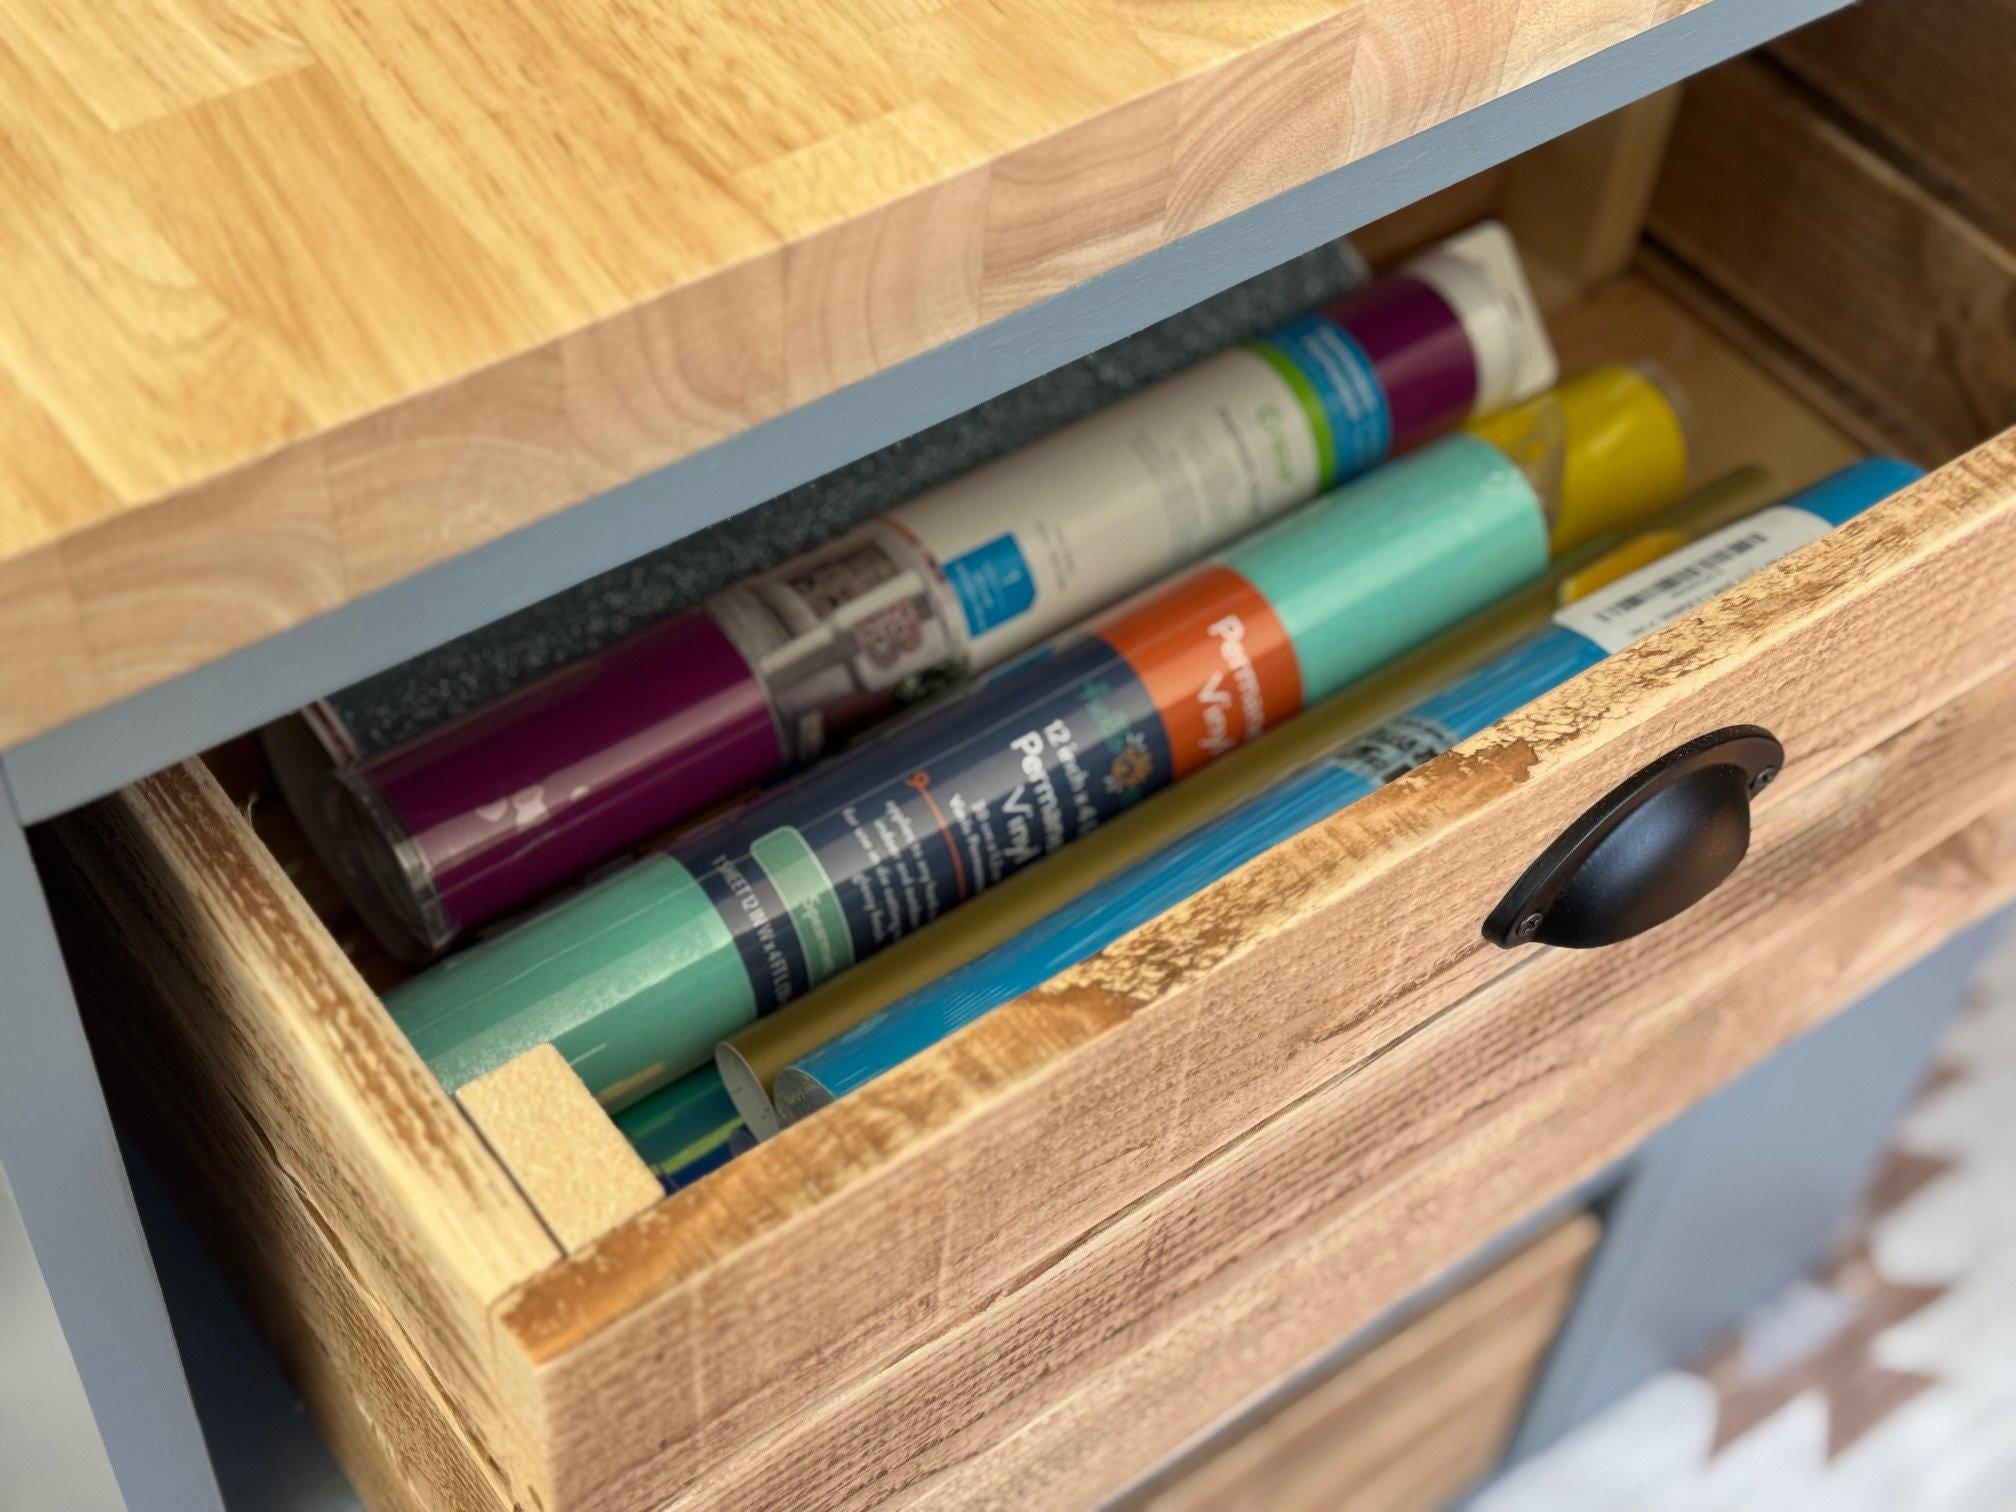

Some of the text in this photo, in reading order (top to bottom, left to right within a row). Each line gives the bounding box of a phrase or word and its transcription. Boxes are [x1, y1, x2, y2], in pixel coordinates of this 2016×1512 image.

[1044, 718, 1072, 748] 12
[1198, 671, 1239, 756] Vinyl
[1001, 784, 1042, 868] Vinyl
[740, 893, 760, 912] 12
[756, 923, 777, 946] W
